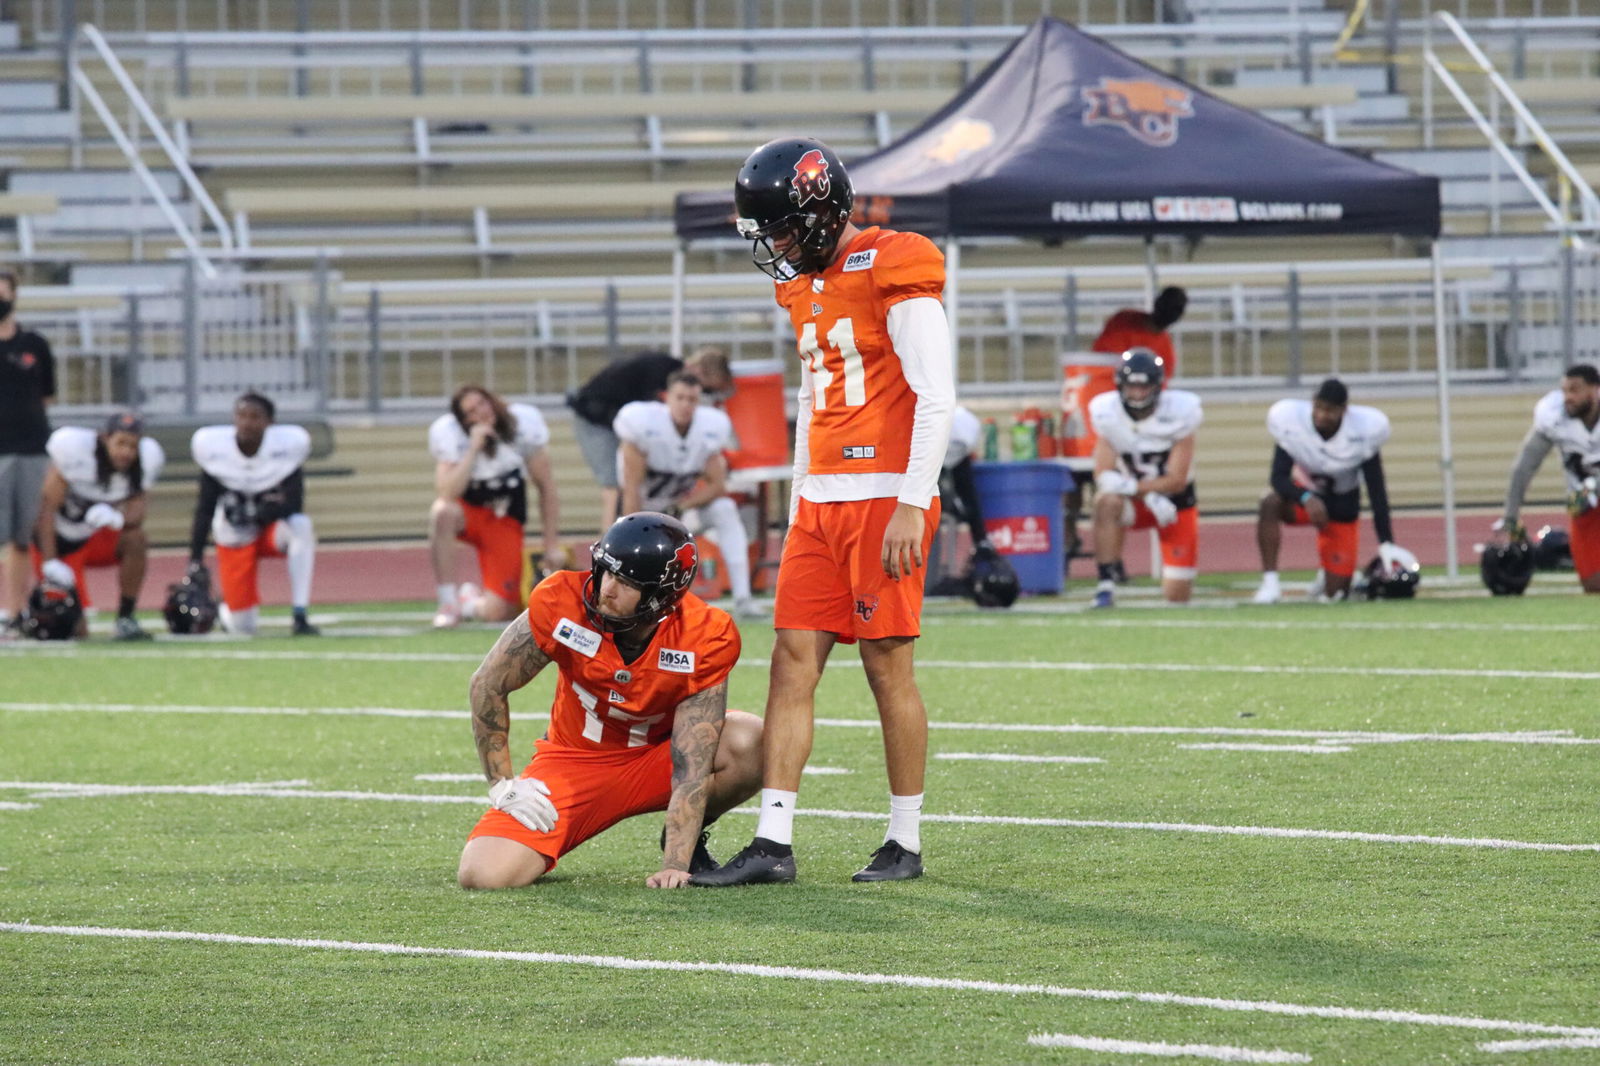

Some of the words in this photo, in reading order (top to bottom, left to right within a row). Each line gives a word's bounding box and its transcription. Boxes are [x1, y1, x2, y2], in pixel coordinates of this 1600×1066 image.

[1052, 201, 1118, 221] FOLLOW
[847, 252, 871, 264] BOSA
[800, 317, 865, 410] 41
[856, 600, 873, 621] BC
[660, 651, 690, 665] BOSA
[617, 673, 629, 681] CFL
[571, 681, 666, 748] 17
